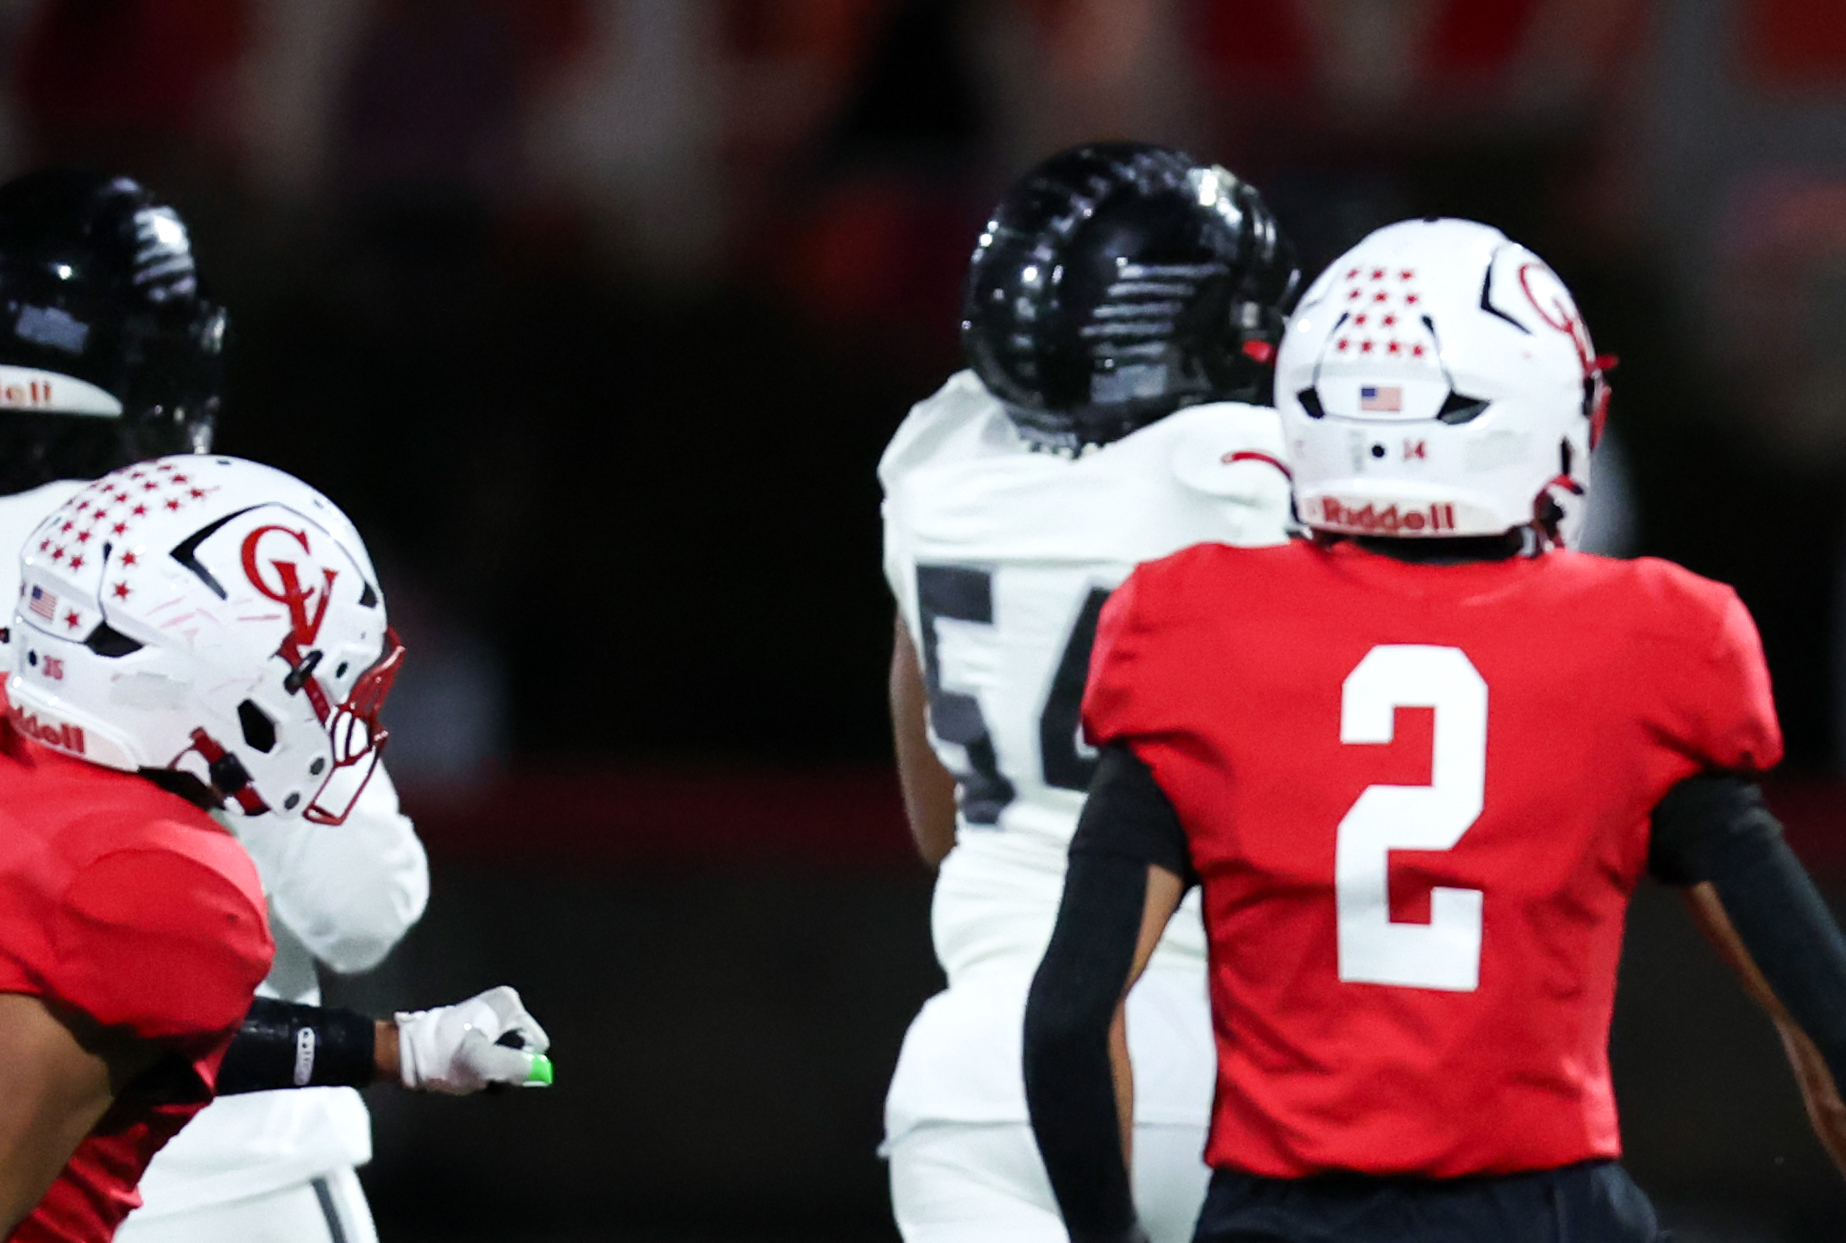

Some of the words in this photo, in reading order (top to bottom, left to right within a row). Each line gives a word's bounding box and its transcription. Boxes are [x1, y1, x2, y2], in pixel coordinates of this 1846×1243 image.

[1322, 496, 1455, 531] Riddell
[241, 525, 340, 646] CV
[1335, 644, 1488, 992] 2
